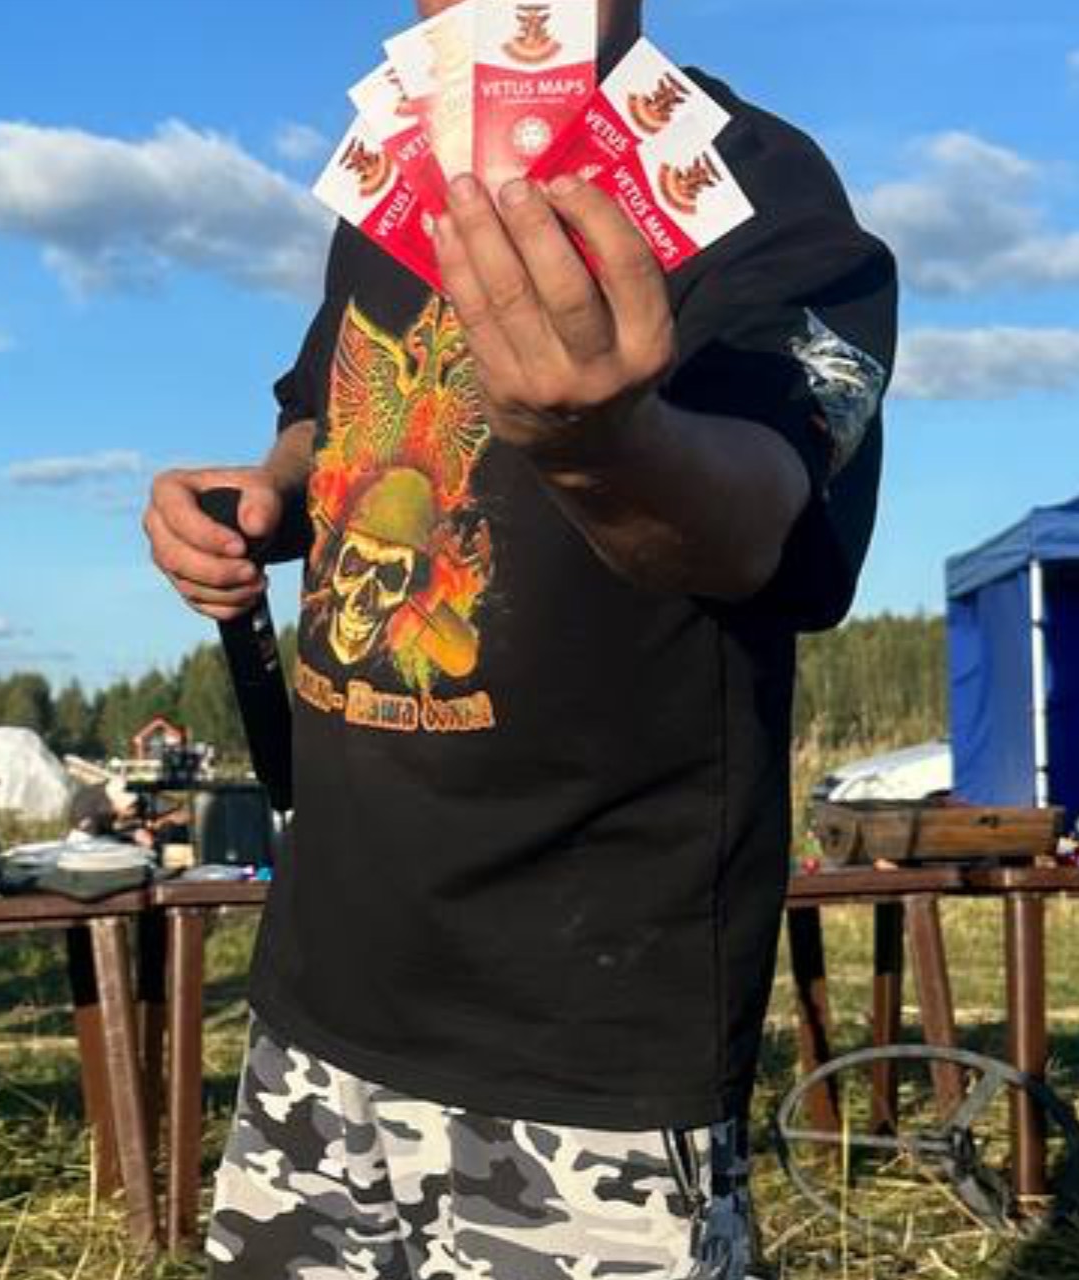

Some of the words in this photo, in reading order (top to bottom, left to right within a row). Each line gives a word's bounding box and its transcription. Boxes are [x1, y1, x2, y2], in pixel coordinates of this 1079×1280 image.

[481, 79, 535, 97] VETUS
[538, 78, 586, 96] MAPS
[584, 108, 629, 153] VETUS
[375, 186, 411, 237] VETUS
[612, 165, 654, 217] VETUS
[644, 214, 680, 261] MAPS
